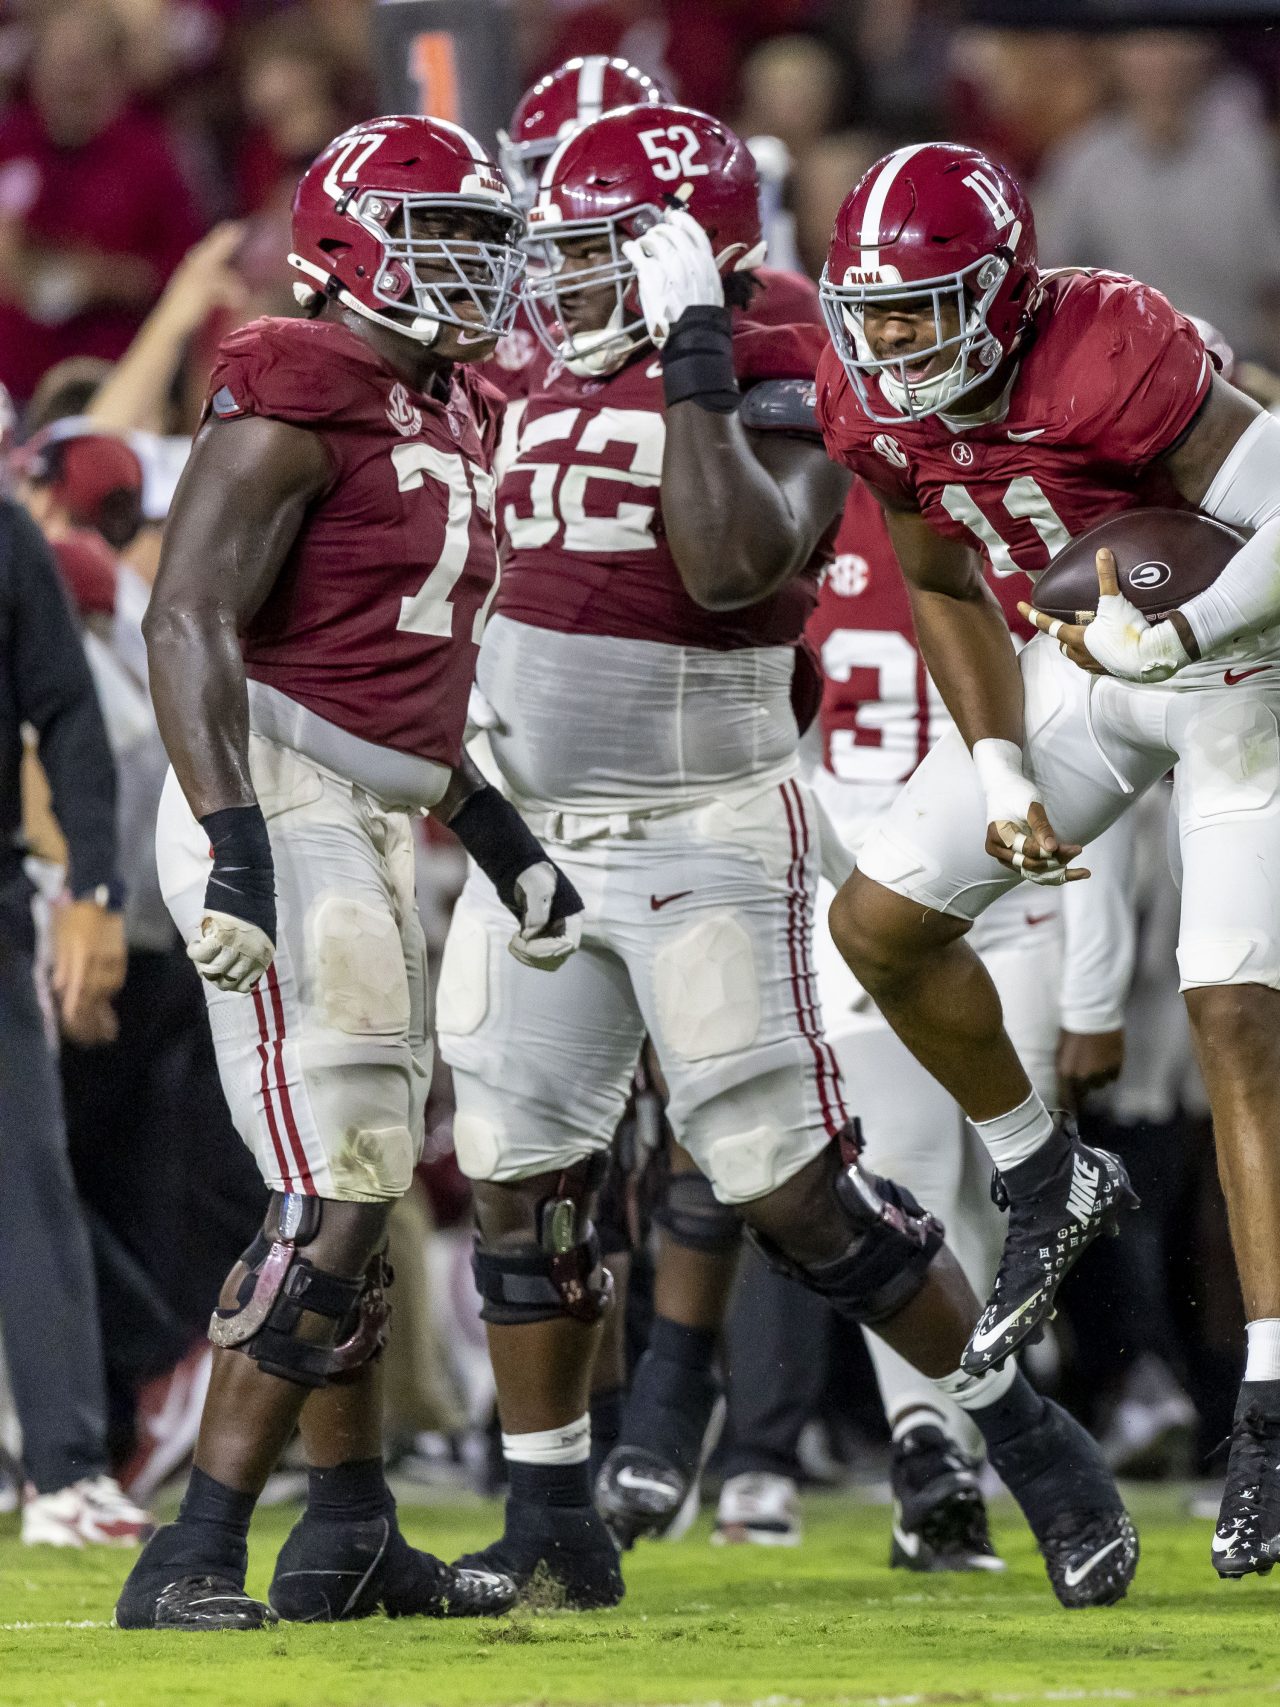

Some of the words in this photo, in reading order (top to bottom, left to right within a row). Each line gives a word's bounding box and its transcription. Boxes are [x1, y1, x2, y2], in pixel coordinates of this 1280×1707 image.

[407, 32, 457, 119] 1
[323, 134, 387, 182] 77
[637, 125, 709, 181] 52
[962, 170, 1015, 231] 11
[494, 400, 666, 551] 52
[941, 476, 1072, 583] 11
[821, 629, 955, 785] 3
[1066, 1152, 1099, 1226] NIKE
